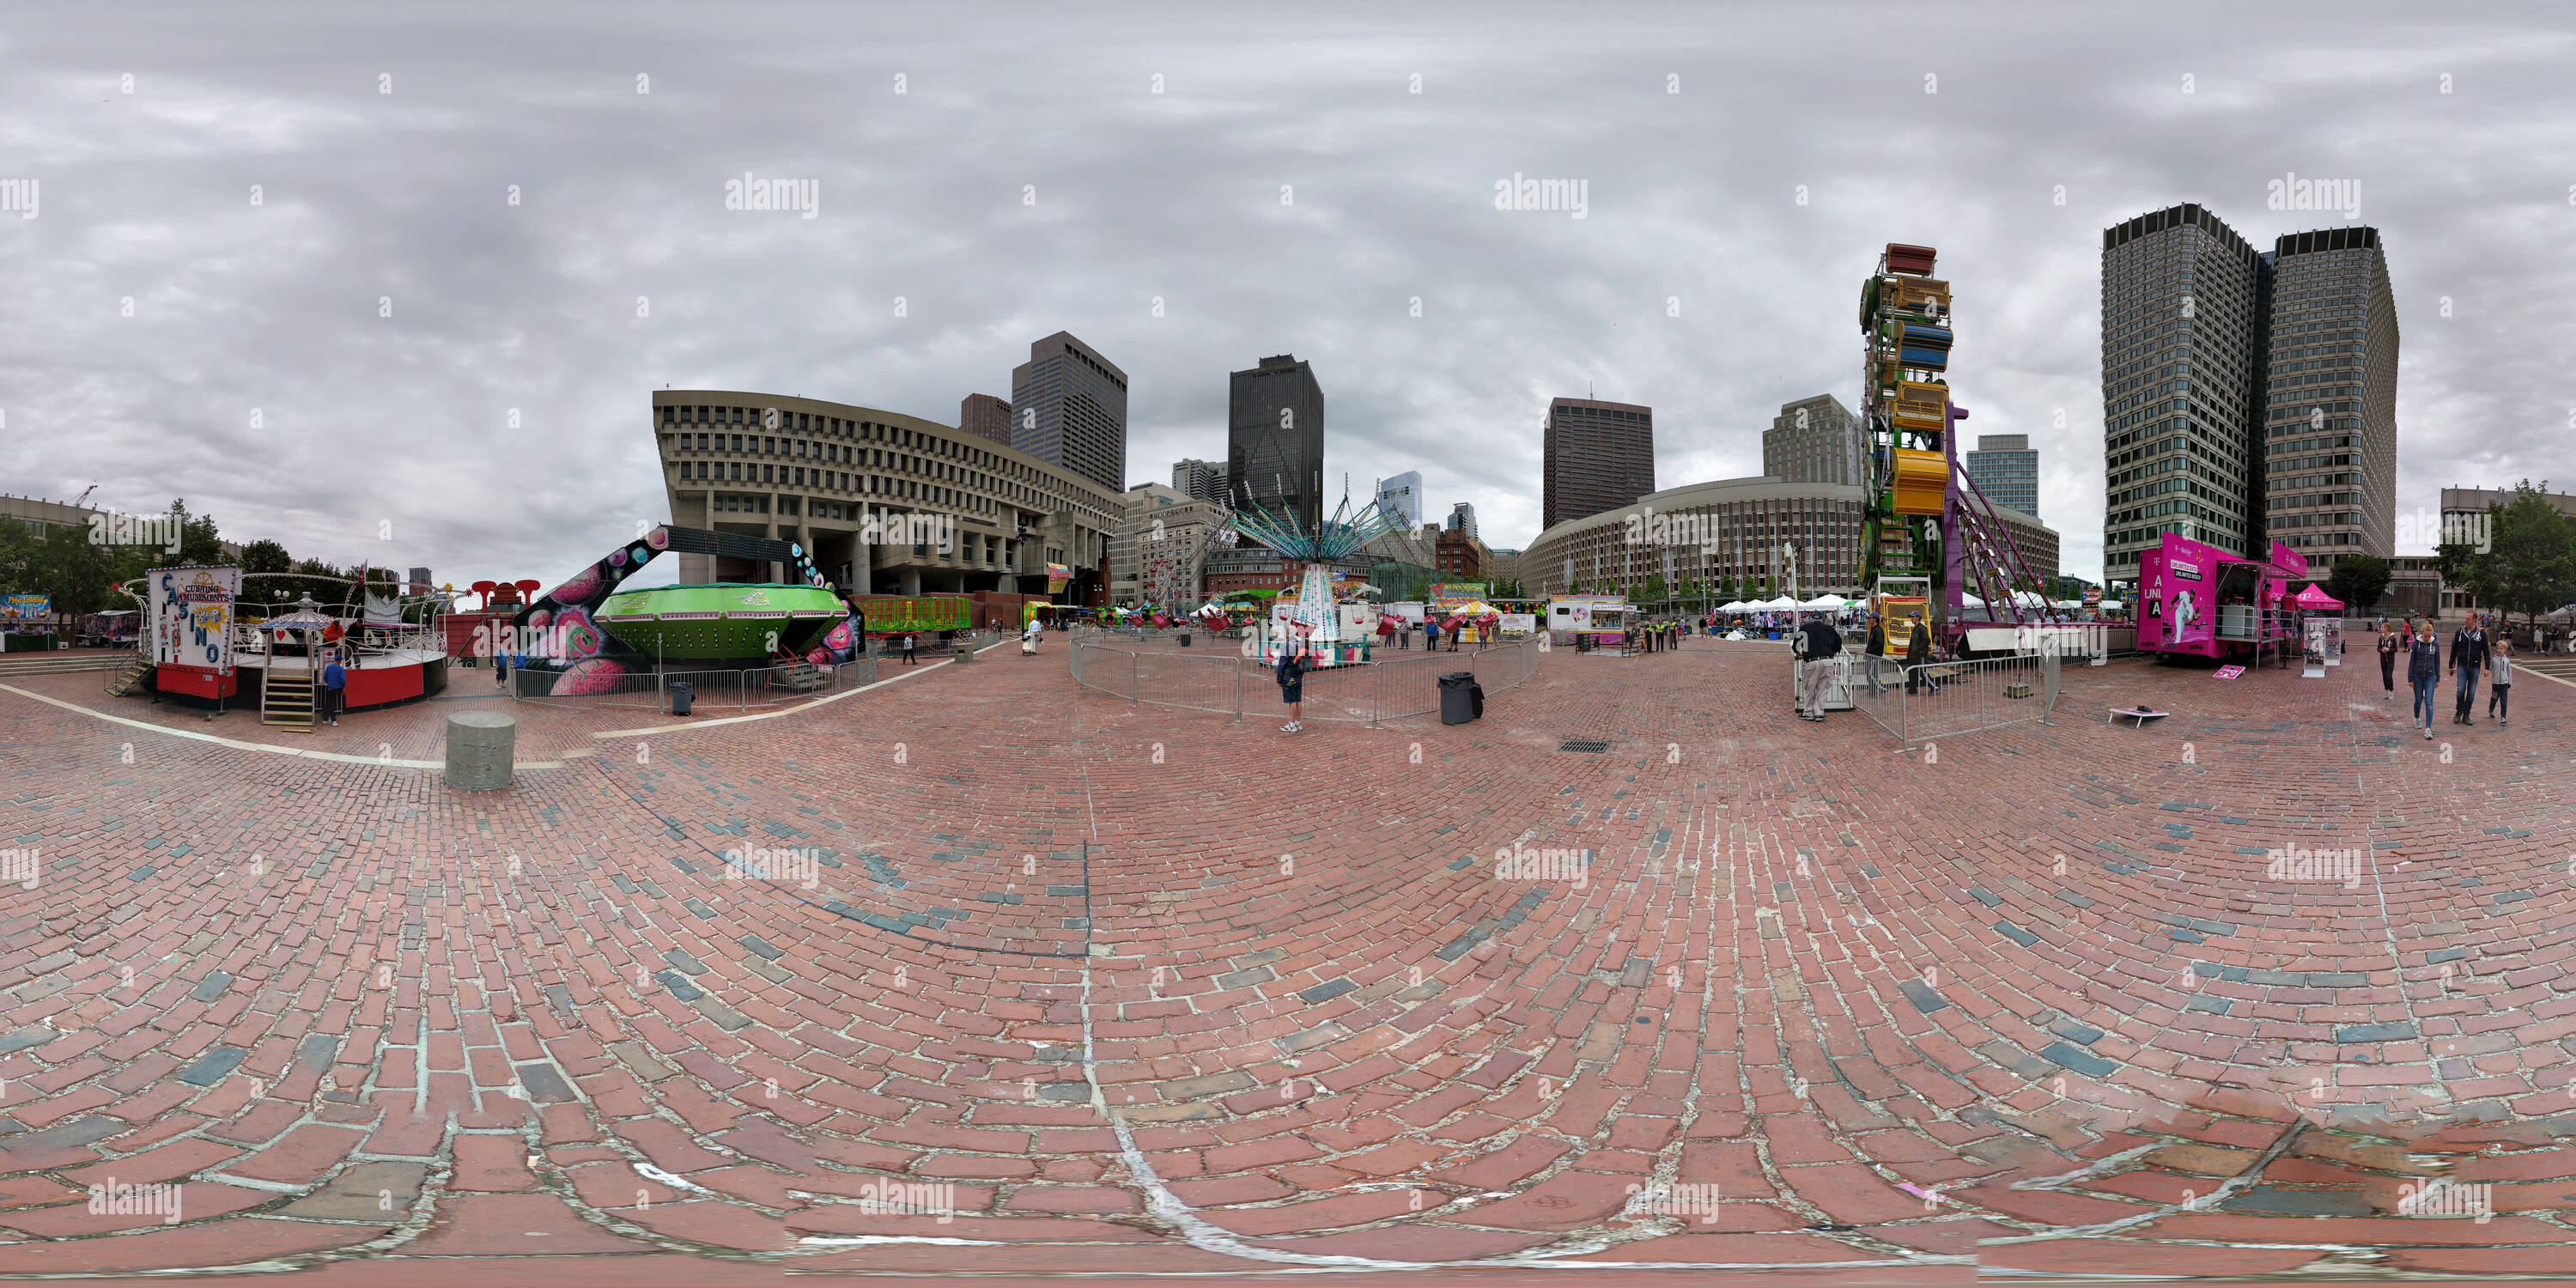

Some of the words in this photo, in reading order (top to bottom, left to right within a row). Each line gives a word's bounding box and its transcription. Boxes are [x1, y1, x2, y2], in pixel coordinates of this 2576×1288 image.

[2175, 570, 2192, 579] UNLIMITED
[185, 585, 219, 593] CUSHING
[162, 573, 218, 663] CASINO
